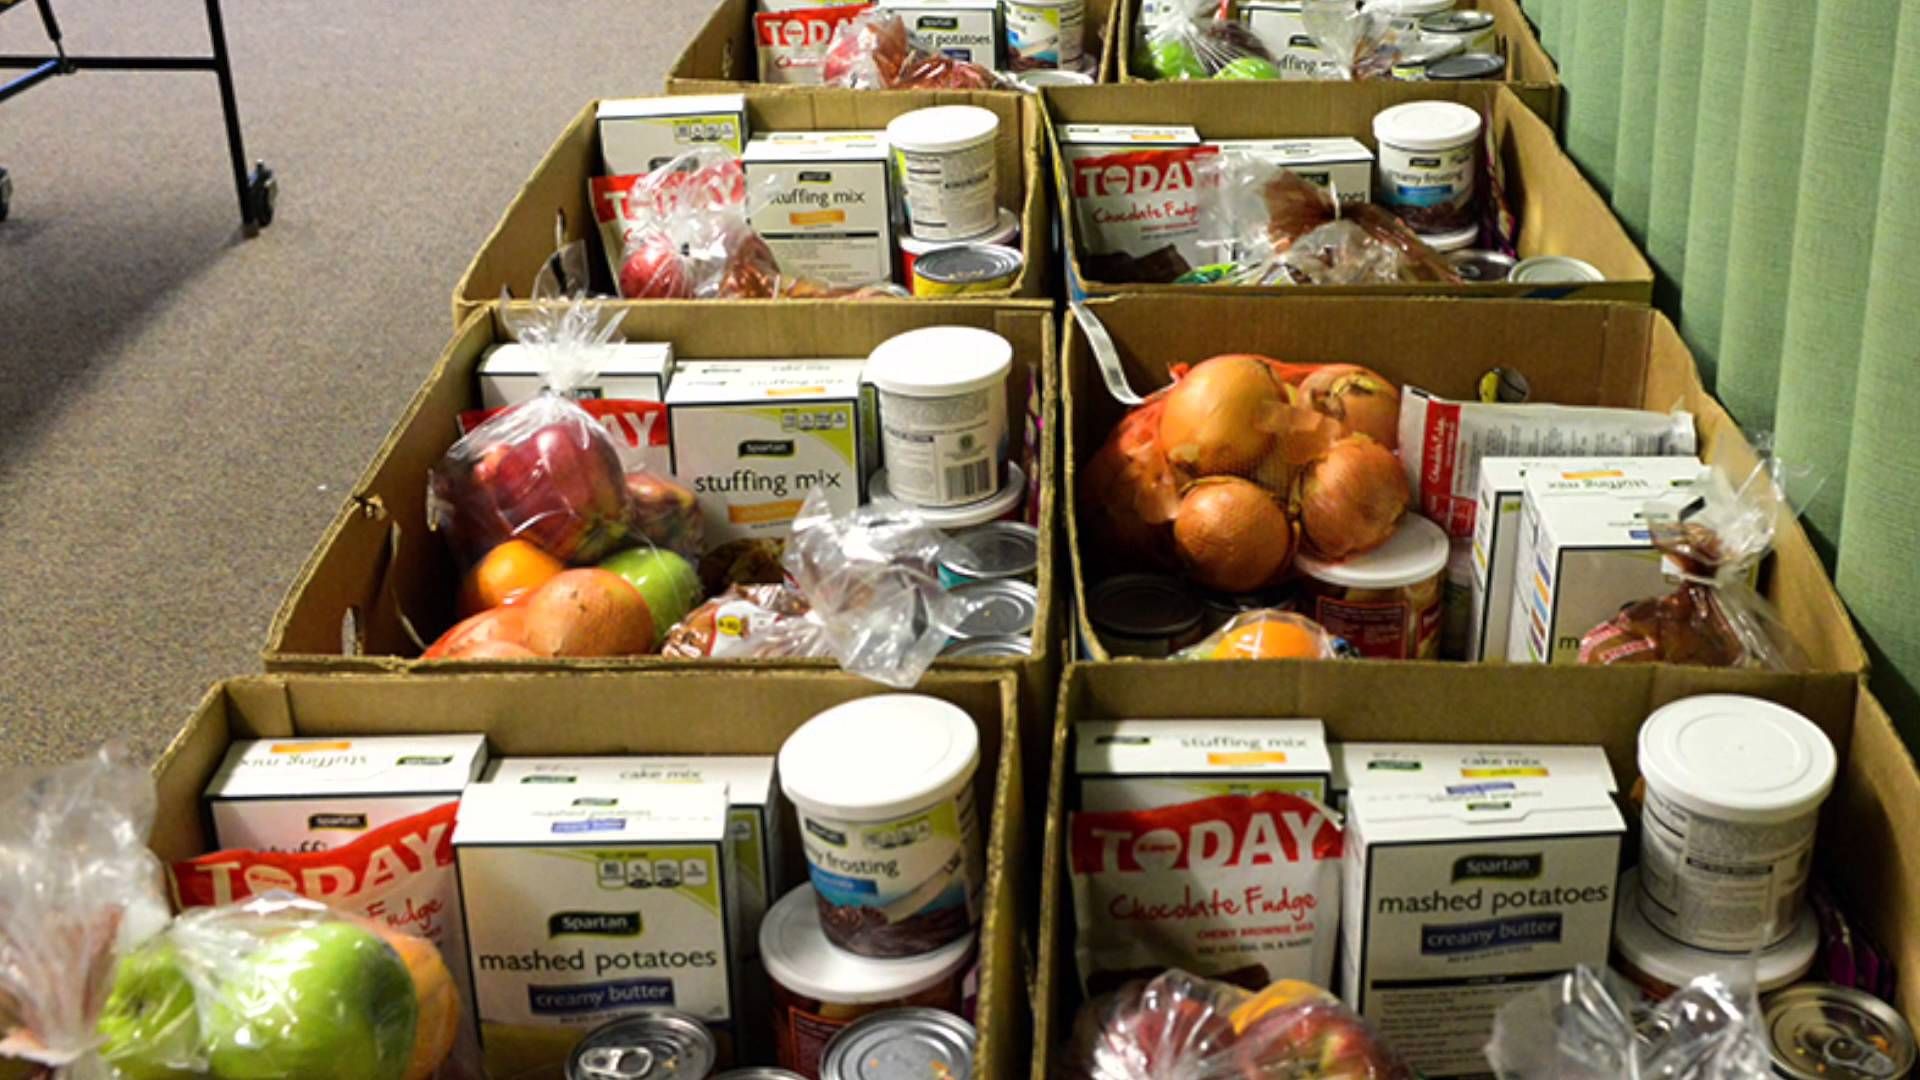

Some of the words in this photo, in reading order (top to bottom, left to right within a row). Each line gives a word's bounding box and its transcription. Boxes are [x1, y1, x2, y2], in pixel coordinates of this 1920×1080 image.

[764, 17, 852, 48] TODA
[936, 32, 992, 46] potatoes
[833, 188, 865, 203] mix
[1163, 200, 1200, 222] Fudg
[694, 469, 788, 497] stuffing
[795, 469, 841, 488] mix
[1090, 810, 1327, 872] TODAY
[193, 823, 449, 908] TODAY
[825, 851, 901, 878] frosting
[1465, 858, 1531, 874] Spartan
[1109, 885, 1240, 922] Chocolate
[1243, 885, 1318, 921] Fudge
[1377, 888, 1483, 914] mashed
[1491, 884, 1609, 915] potatoes
[365, 898, 443, 932] Fudge
[562, 916, 628, 931] Spartan
[1426, 928, 1495, 946] creamy
[1500, 920, 1557, 938] butter
[479, 948, 585, 972] mashed
[596, 949, 718, 975] potatoes
[535, 988, 606, 1009] creamy
[607, 982, 669, 1001] butter
